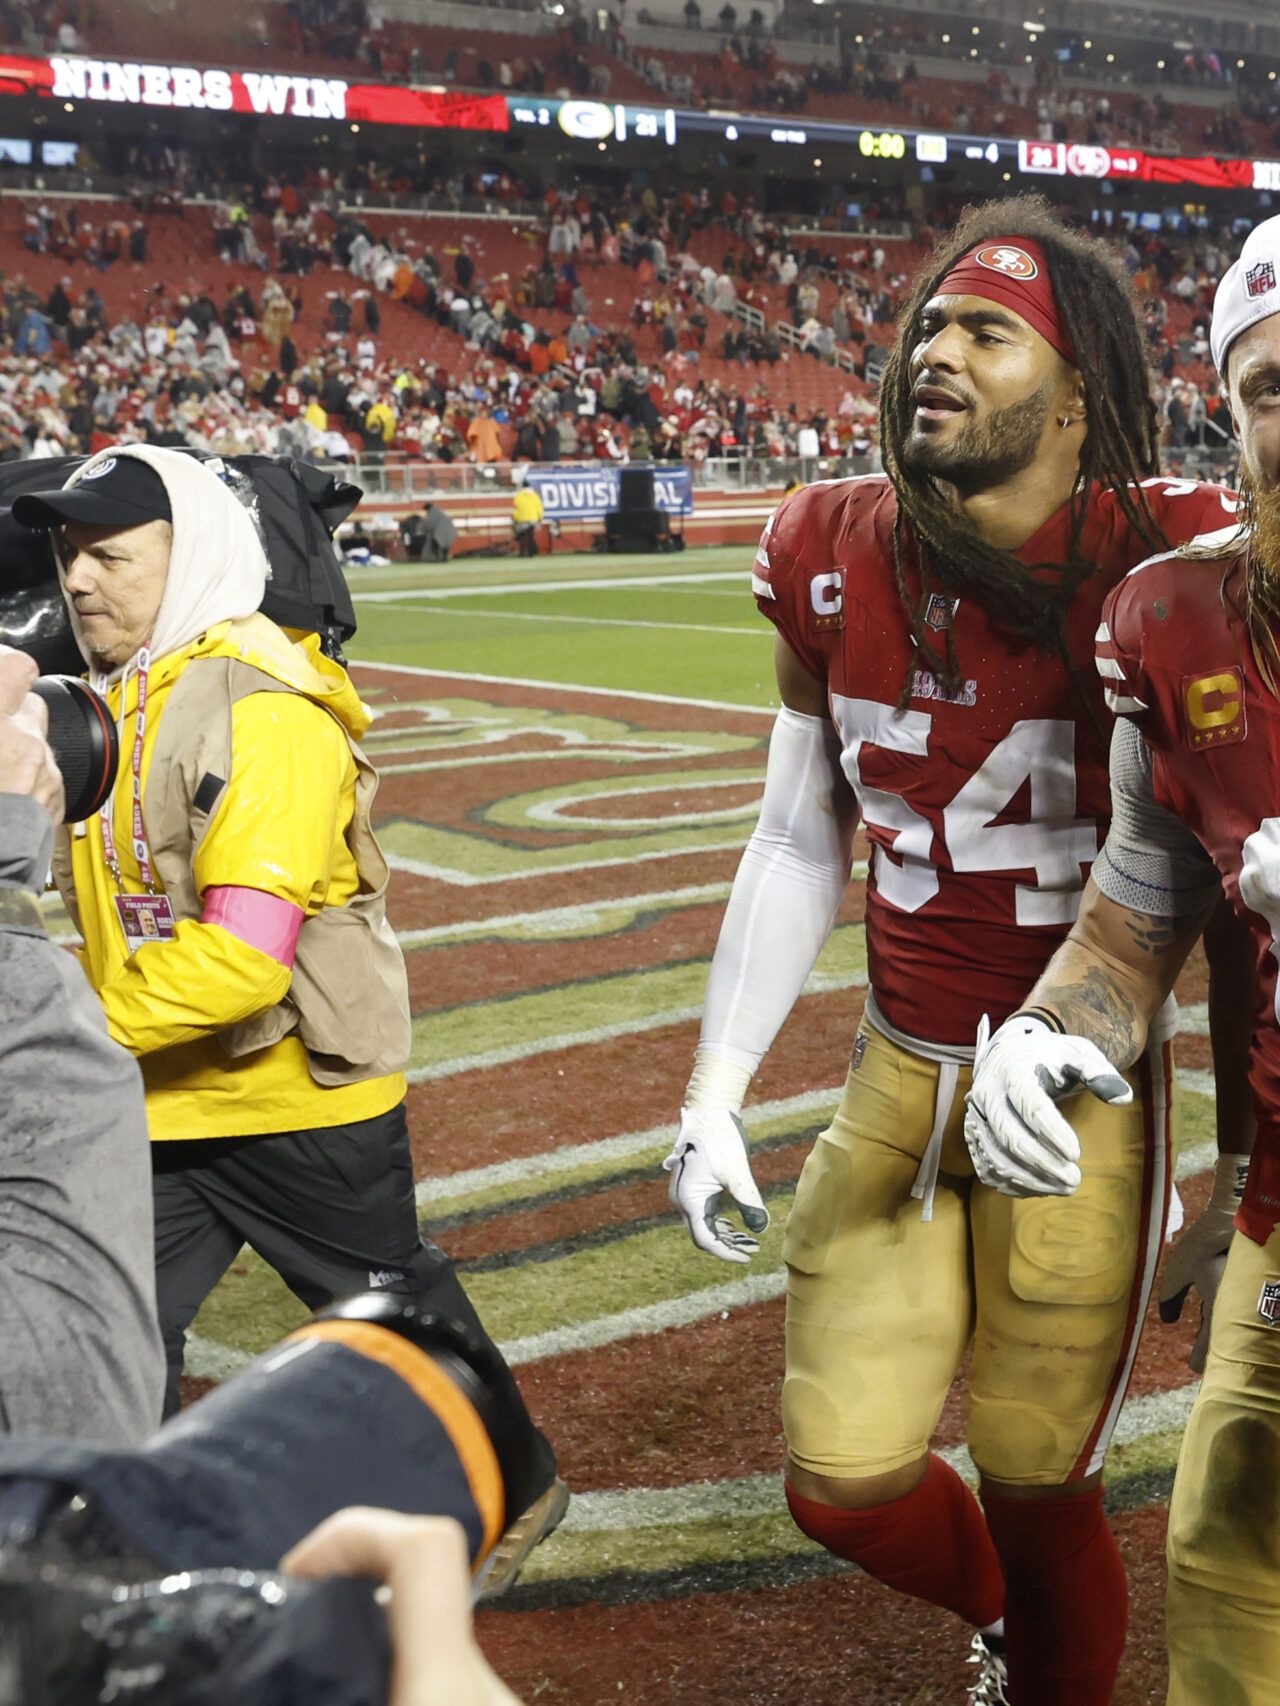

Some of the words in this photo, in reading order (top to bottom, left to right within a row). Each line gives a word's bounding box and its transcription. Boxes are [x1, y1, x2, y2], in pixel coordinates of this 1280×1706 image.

[50, 58, 234, 110] NINERS
[242, 73, 348, 120] WIN
[635, 113, 657, 136] 21
[859, 131, 905, 159] 0:00
[1249, 273, 1275, 297] NFL
[539, 481, 684, 509] DIVISIAL
[810, 571, 842, 616] C
[1187, 671, 1240, 728] C
[831, 692, 1098, 927] 54
